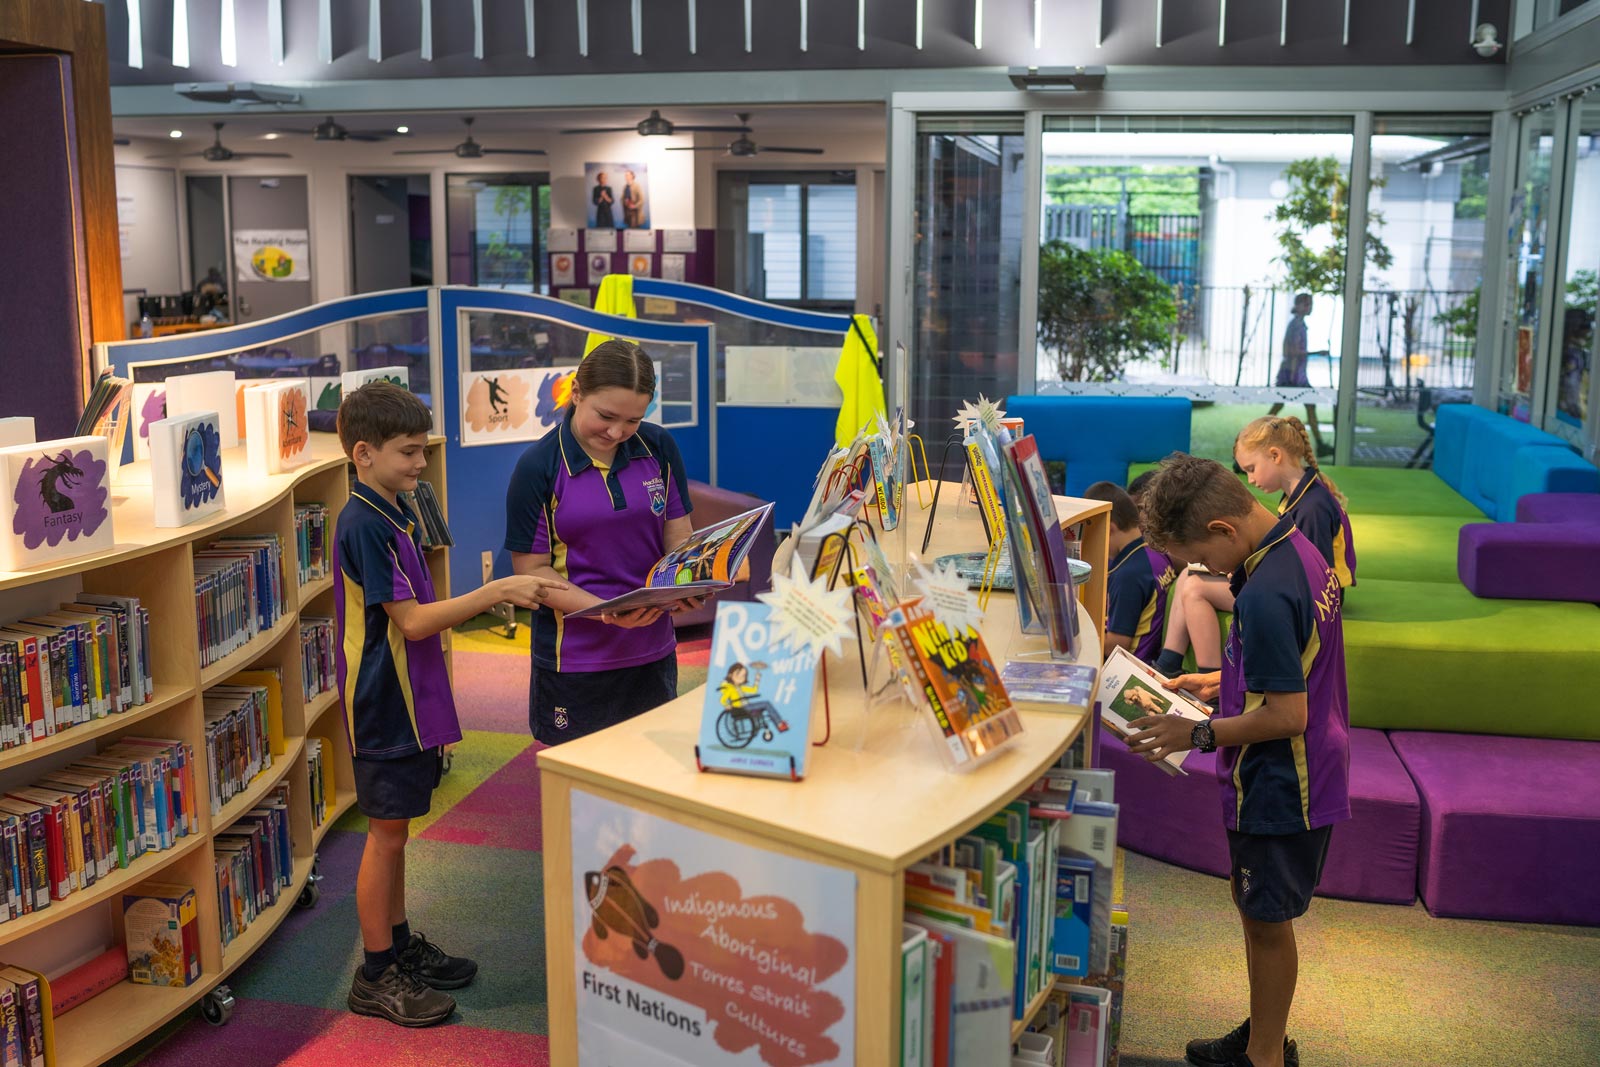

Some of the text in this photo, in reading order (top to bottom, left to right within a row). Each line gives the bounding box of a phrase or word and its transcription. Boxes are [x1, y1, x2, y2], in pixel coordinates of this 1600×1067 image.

[488, 413, 509, 424] Sport
[191, 480, 211, 495] Mystery
[44, 510, 84, 528] Fantasy
[663, 891, 779, 923] Indigenous
[700, 924, 820, 986] Aboriginal
[689, 961, 746, 995] Torres
[582, 970, 702, 1037] First Nations
[749, 983, 812, 1018] Strait
[725, 1001, 807, 1058] Cultures
